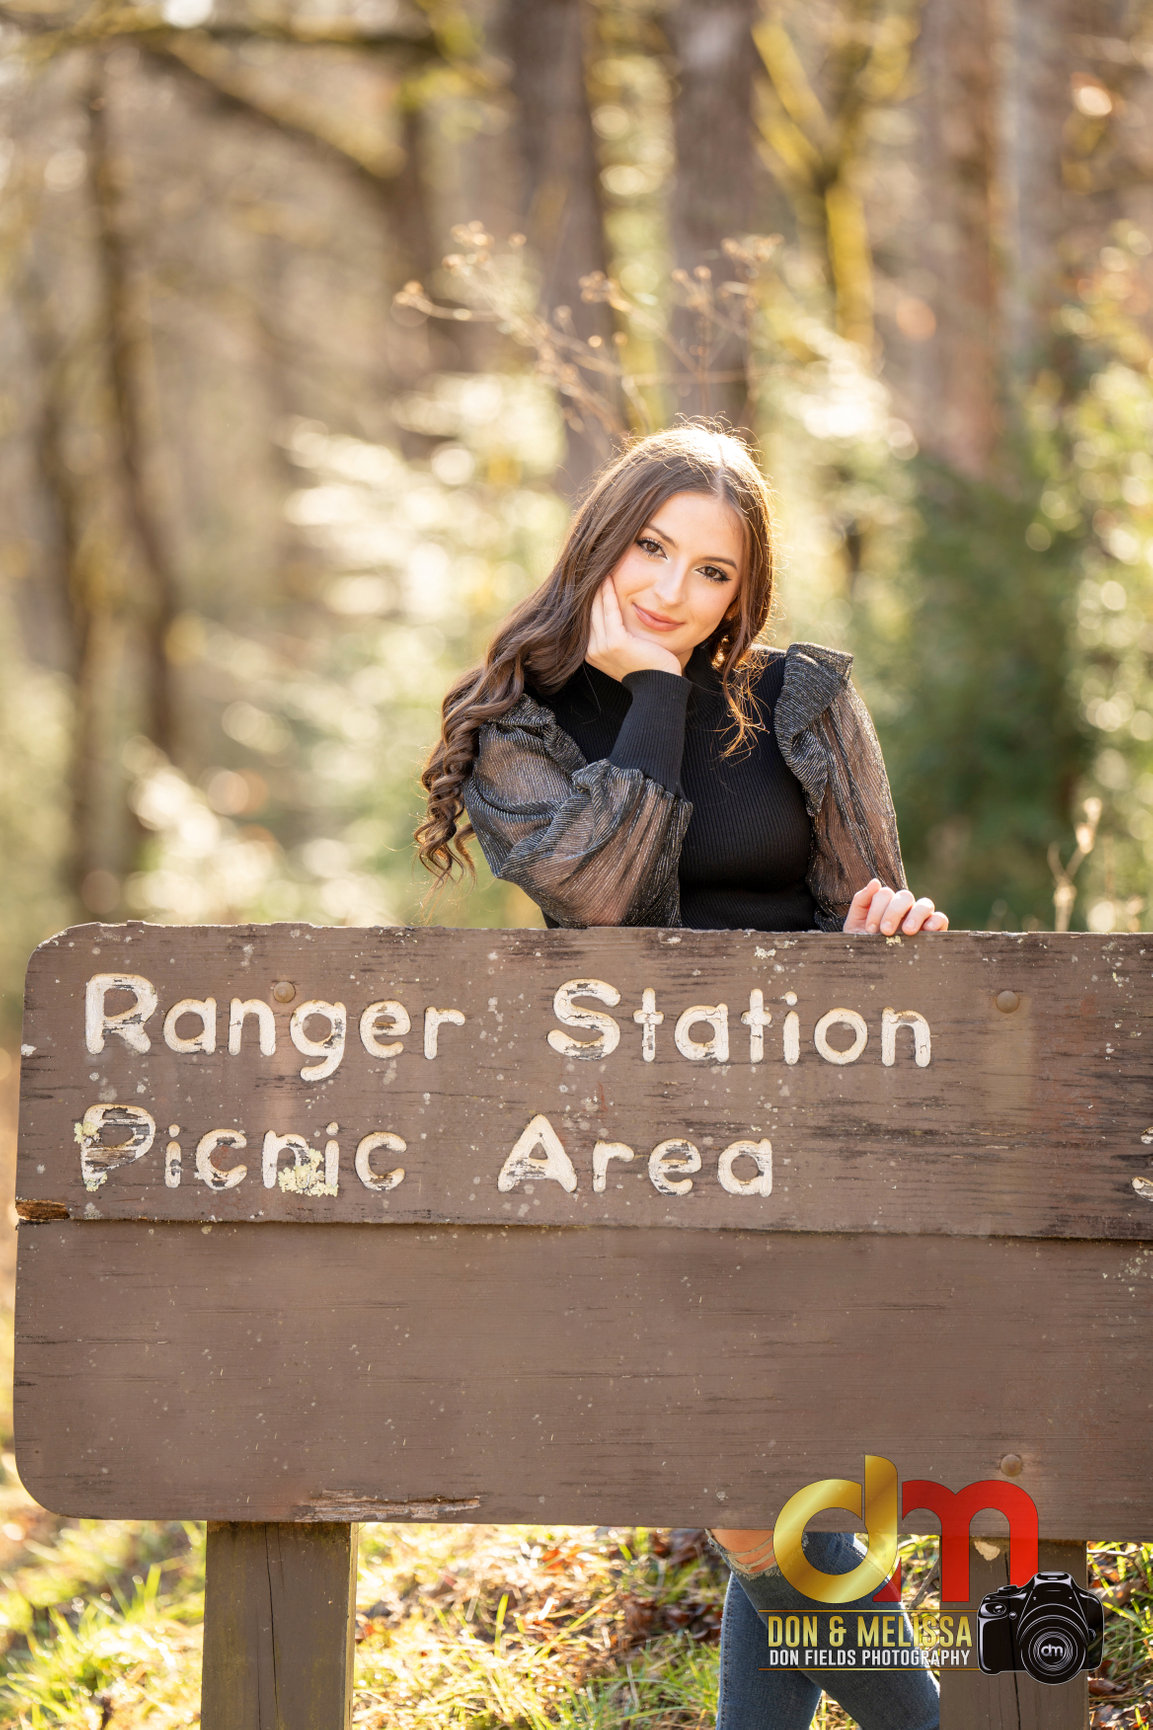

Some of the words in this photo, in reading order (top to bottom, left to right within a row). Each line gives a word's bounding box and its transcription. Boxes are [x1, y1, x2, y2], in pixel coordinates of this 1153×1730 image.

[85, 973, 466, 1082] Ranger
[546, 978, 932, 1068] Station
[80, 1103, 406, 1195] Picnic
[497, 1113, 773, 1198] Area
